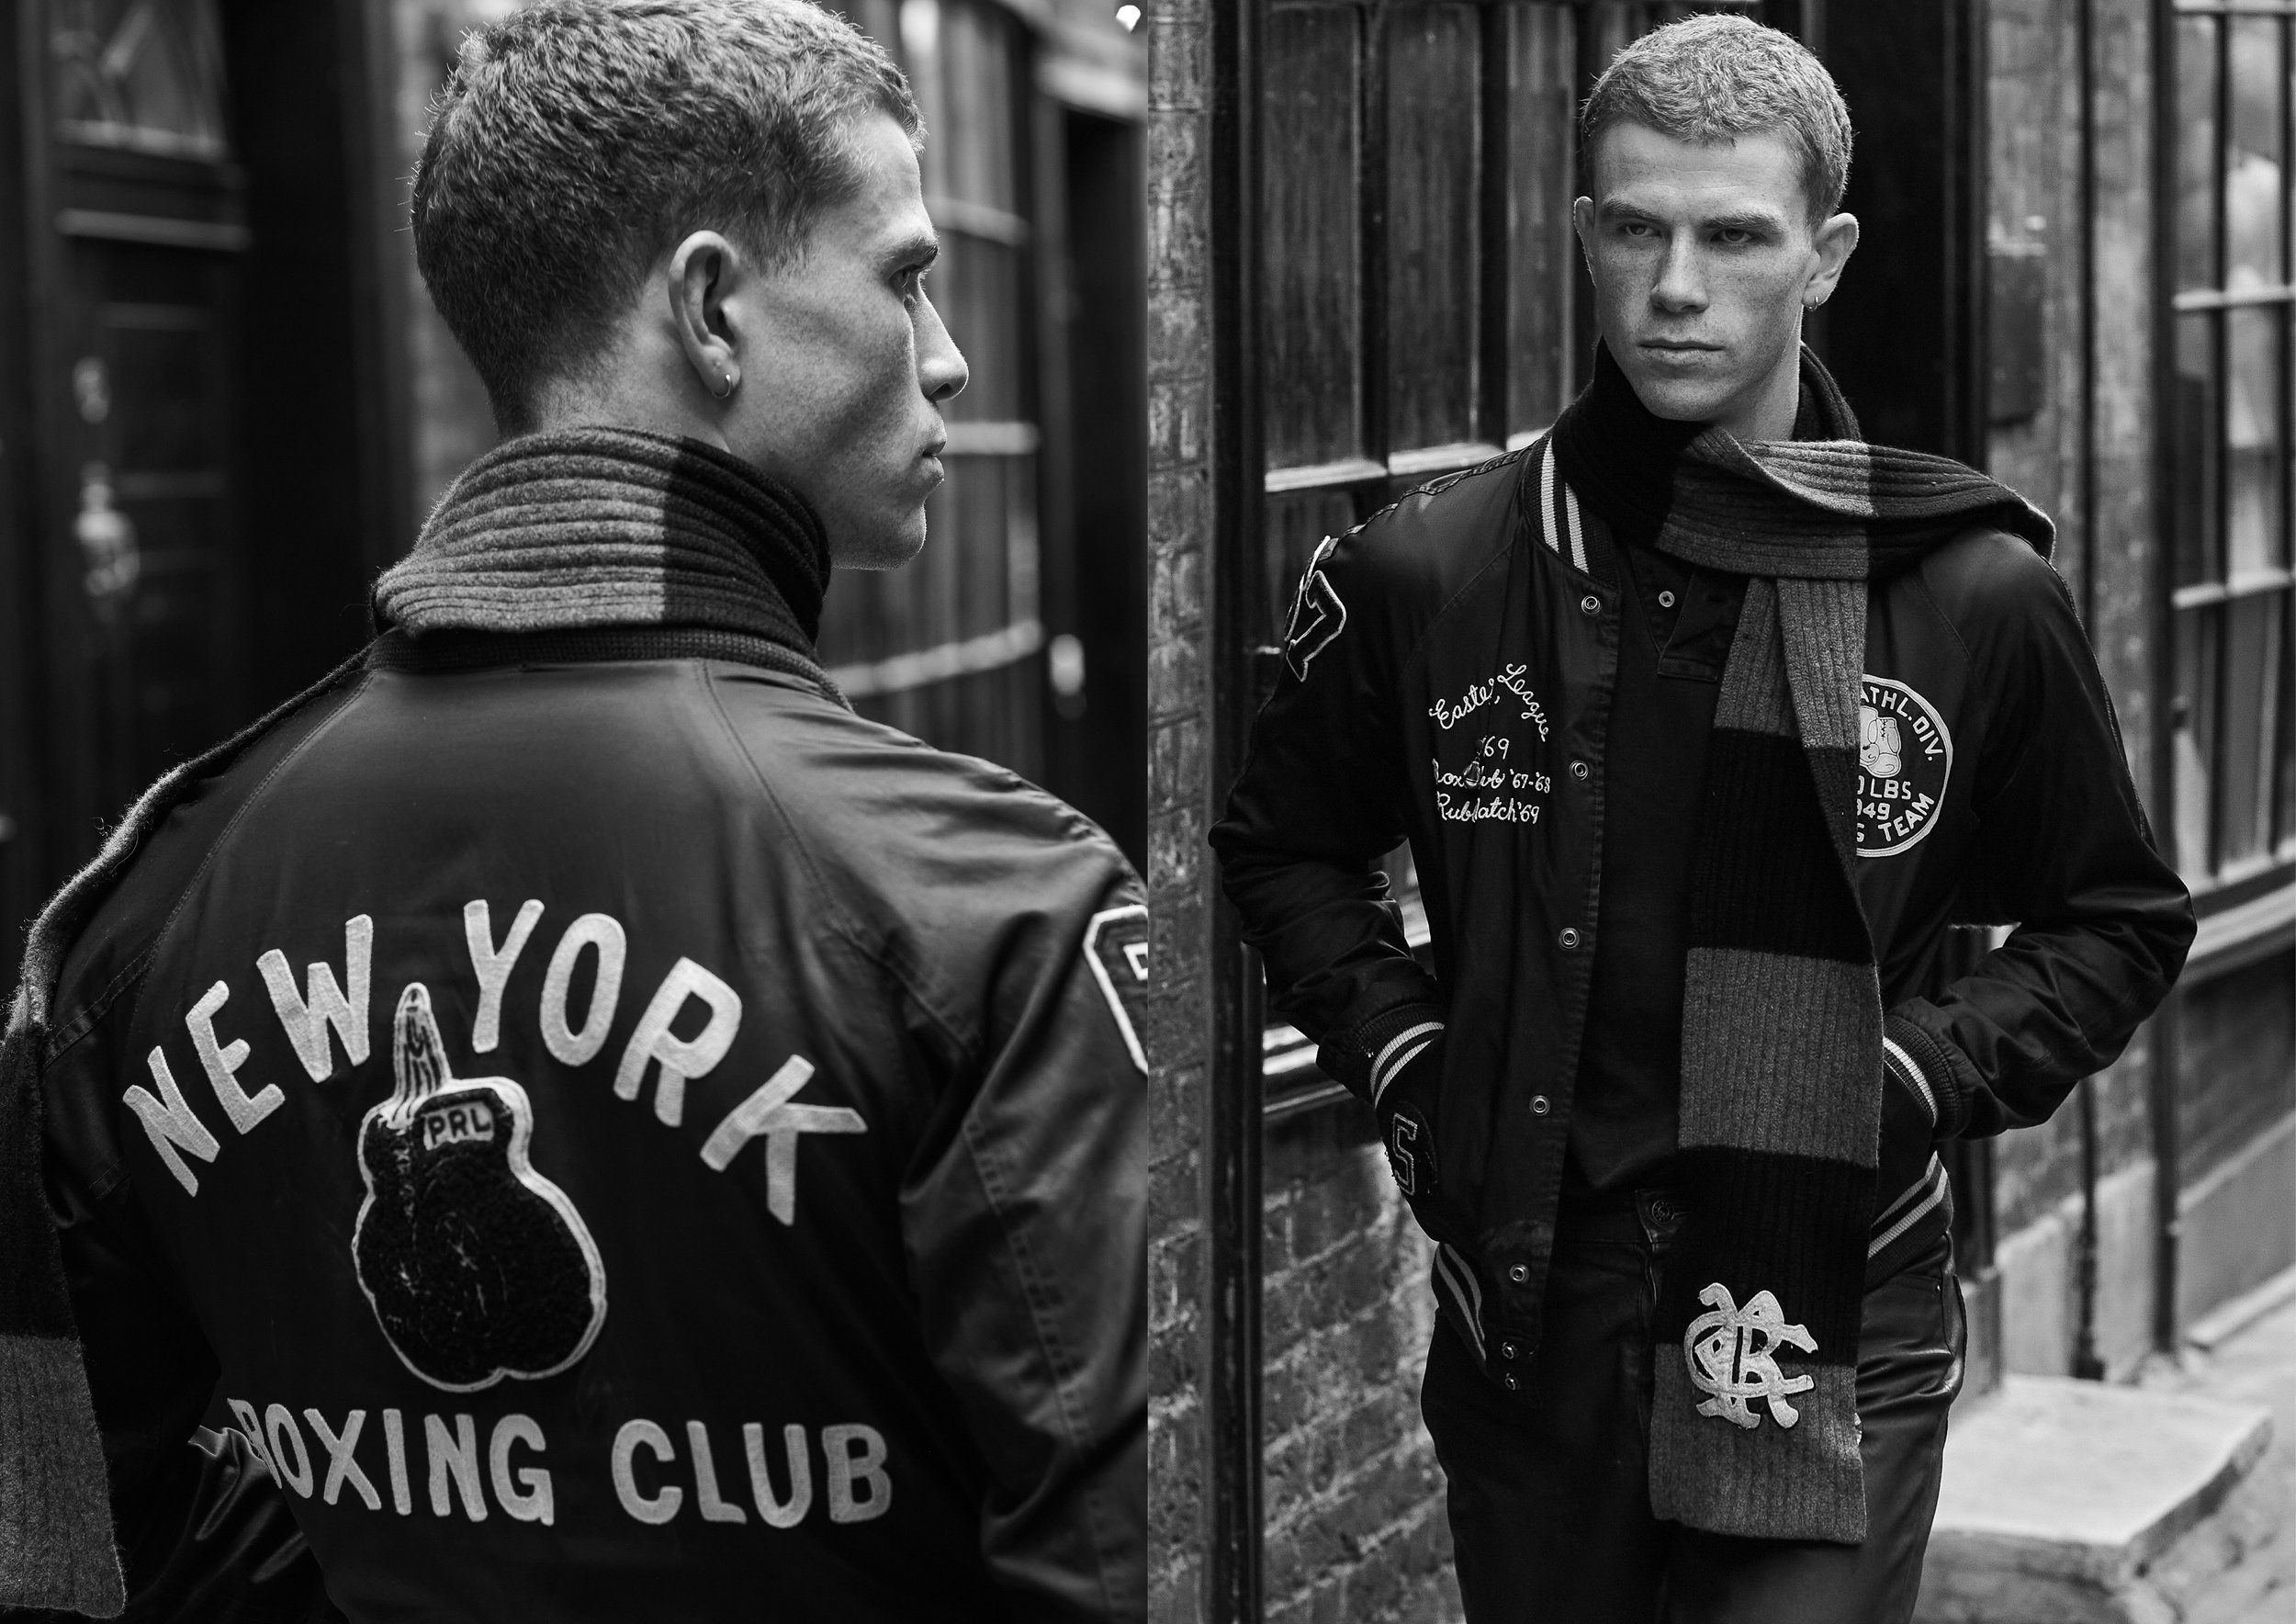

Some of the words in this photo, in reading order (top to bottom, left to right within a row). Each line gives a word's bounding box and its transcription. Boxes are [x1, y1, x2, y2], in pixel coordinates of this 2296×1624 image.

[1497, 663, 1549, 742] League
[1870, 778, 1912, 800] LBS
[1877, 793, 1935, 842] TEAM
[123, 914, 374, 1197] NEW
[464, 899, 868, 1226] YORK
[427, 1107, 491, 1146] PRL
[612, 1418, 893, 1529] CLUB
